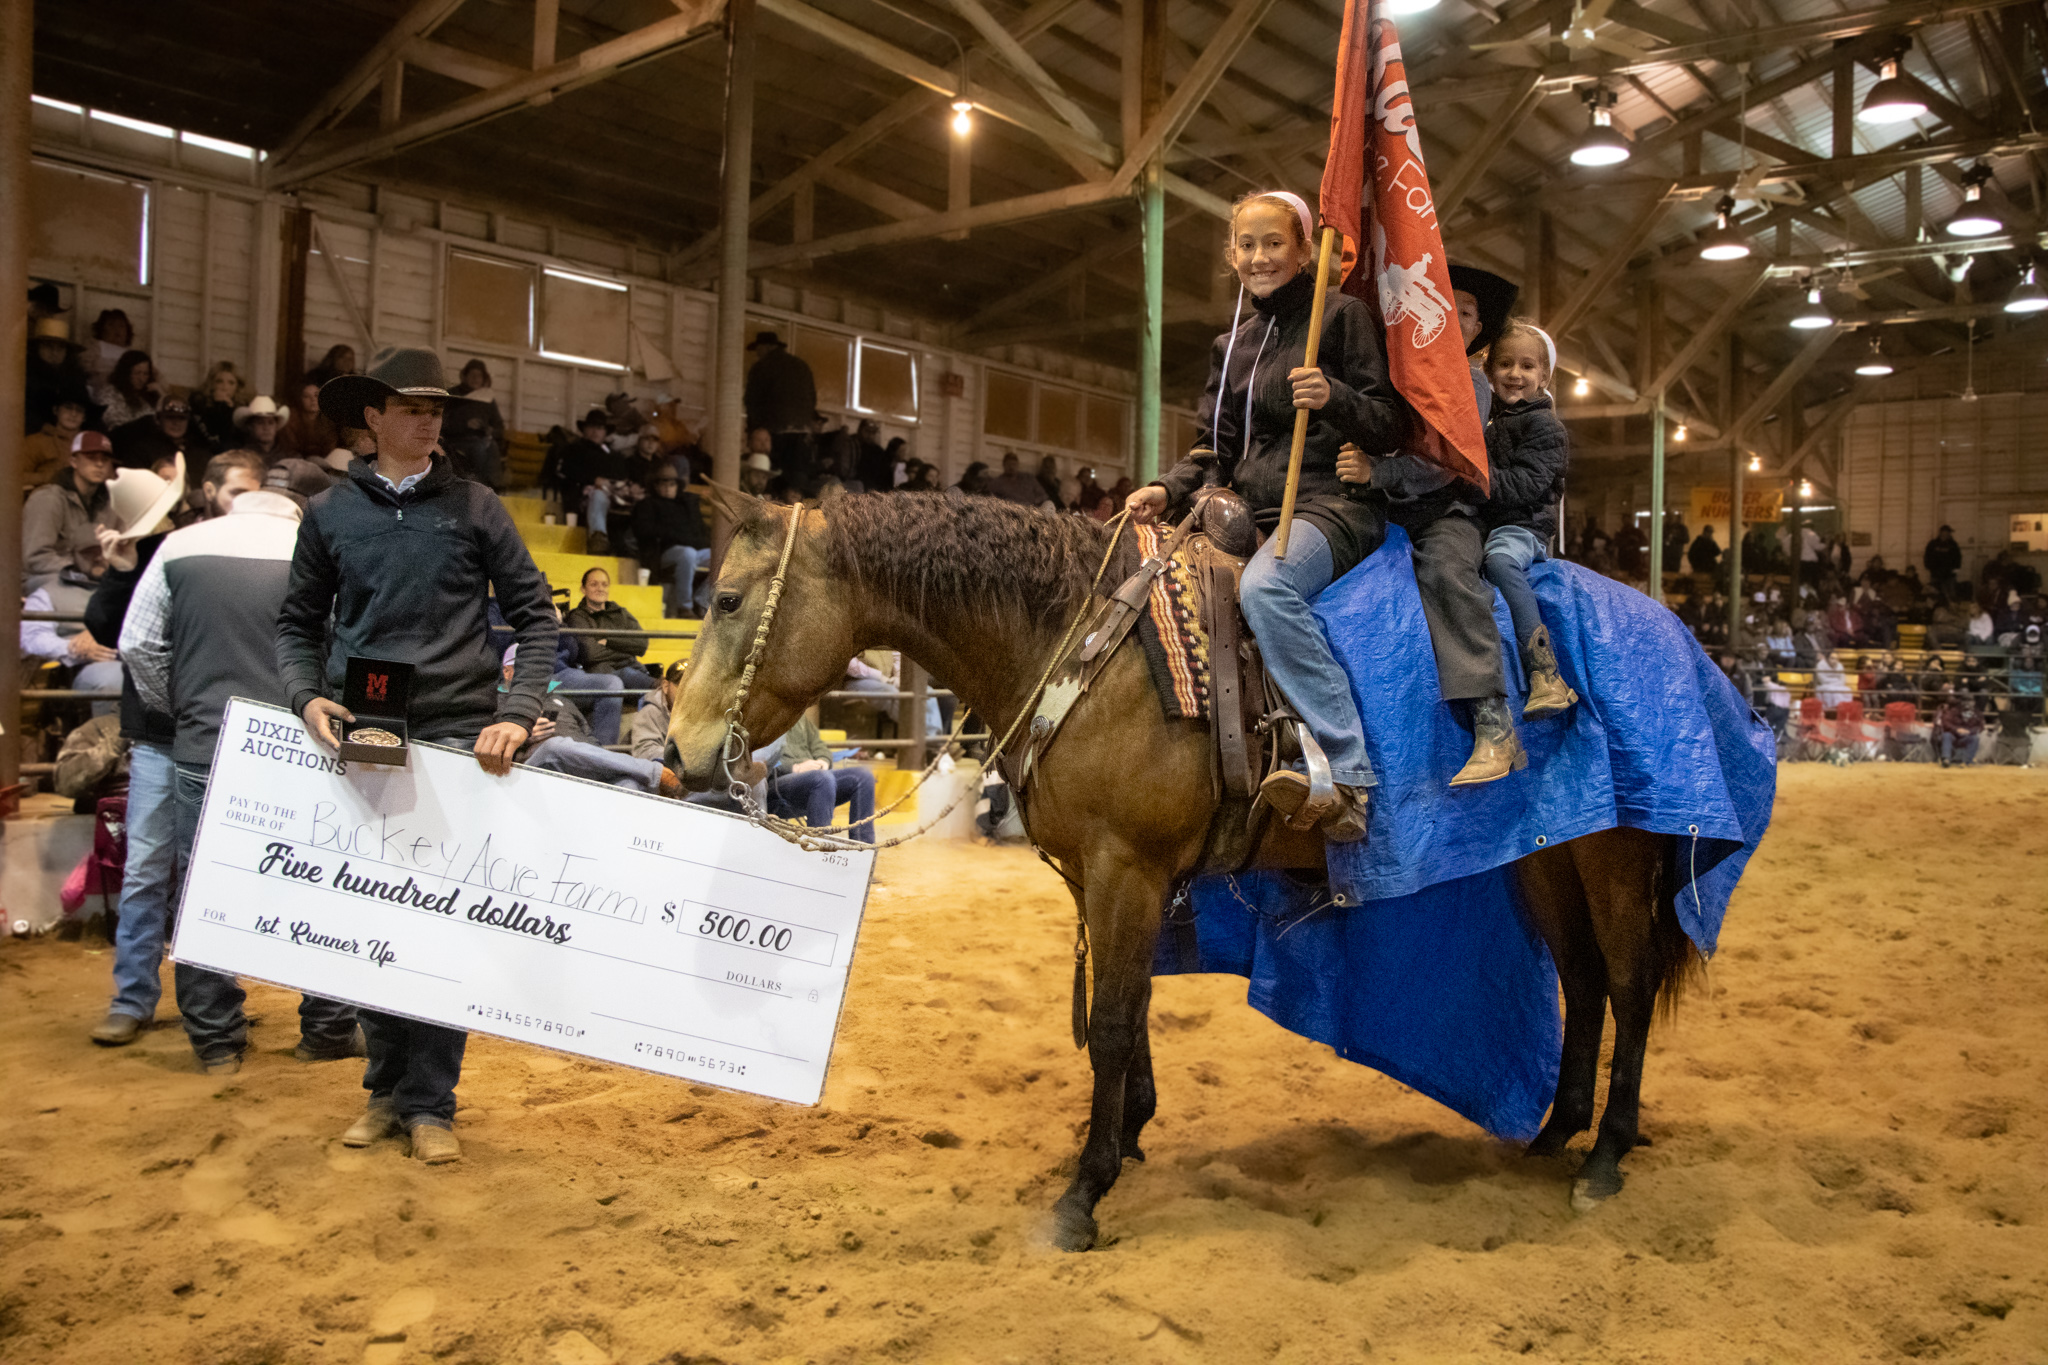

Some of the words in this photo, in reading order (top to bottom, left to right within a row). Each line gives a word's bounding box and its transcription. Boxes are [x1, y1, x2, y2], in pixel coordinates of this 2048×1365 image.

[1711, 491, 1762, 504] BUER
[246, 718, 304, 745] DIXIE
[241, 738, 348, 776] AUCTIONS
[226, 809, 267, 827] ORDER
[269, 818, 286, 832] OF
[229, 795, 251, 810] PAY
[254, 800, 270, 813] TO
[273, 804, 297, 820] THE
[632, 836, 665, 852] DATE
[822, 853, 849, 867] 5673
[463, 833, 538, 898] Acre
[550, 852, 638, 922] Farm
[259, 841, 323, 883] Five
[333, 861, 460, 915] hundred
[467, 895, 572, 944] dollars
[203, 908, 227, 923] FOR
[254, 914, 281, 936] 1st.
[290, 920, 360, 955] Runner
[368, 939, 397, 967] Up
[661, 900, 676, 925] $
[699, 910, 792, 952] 500.00
[725, 970, 783, 992] DOLLARS
